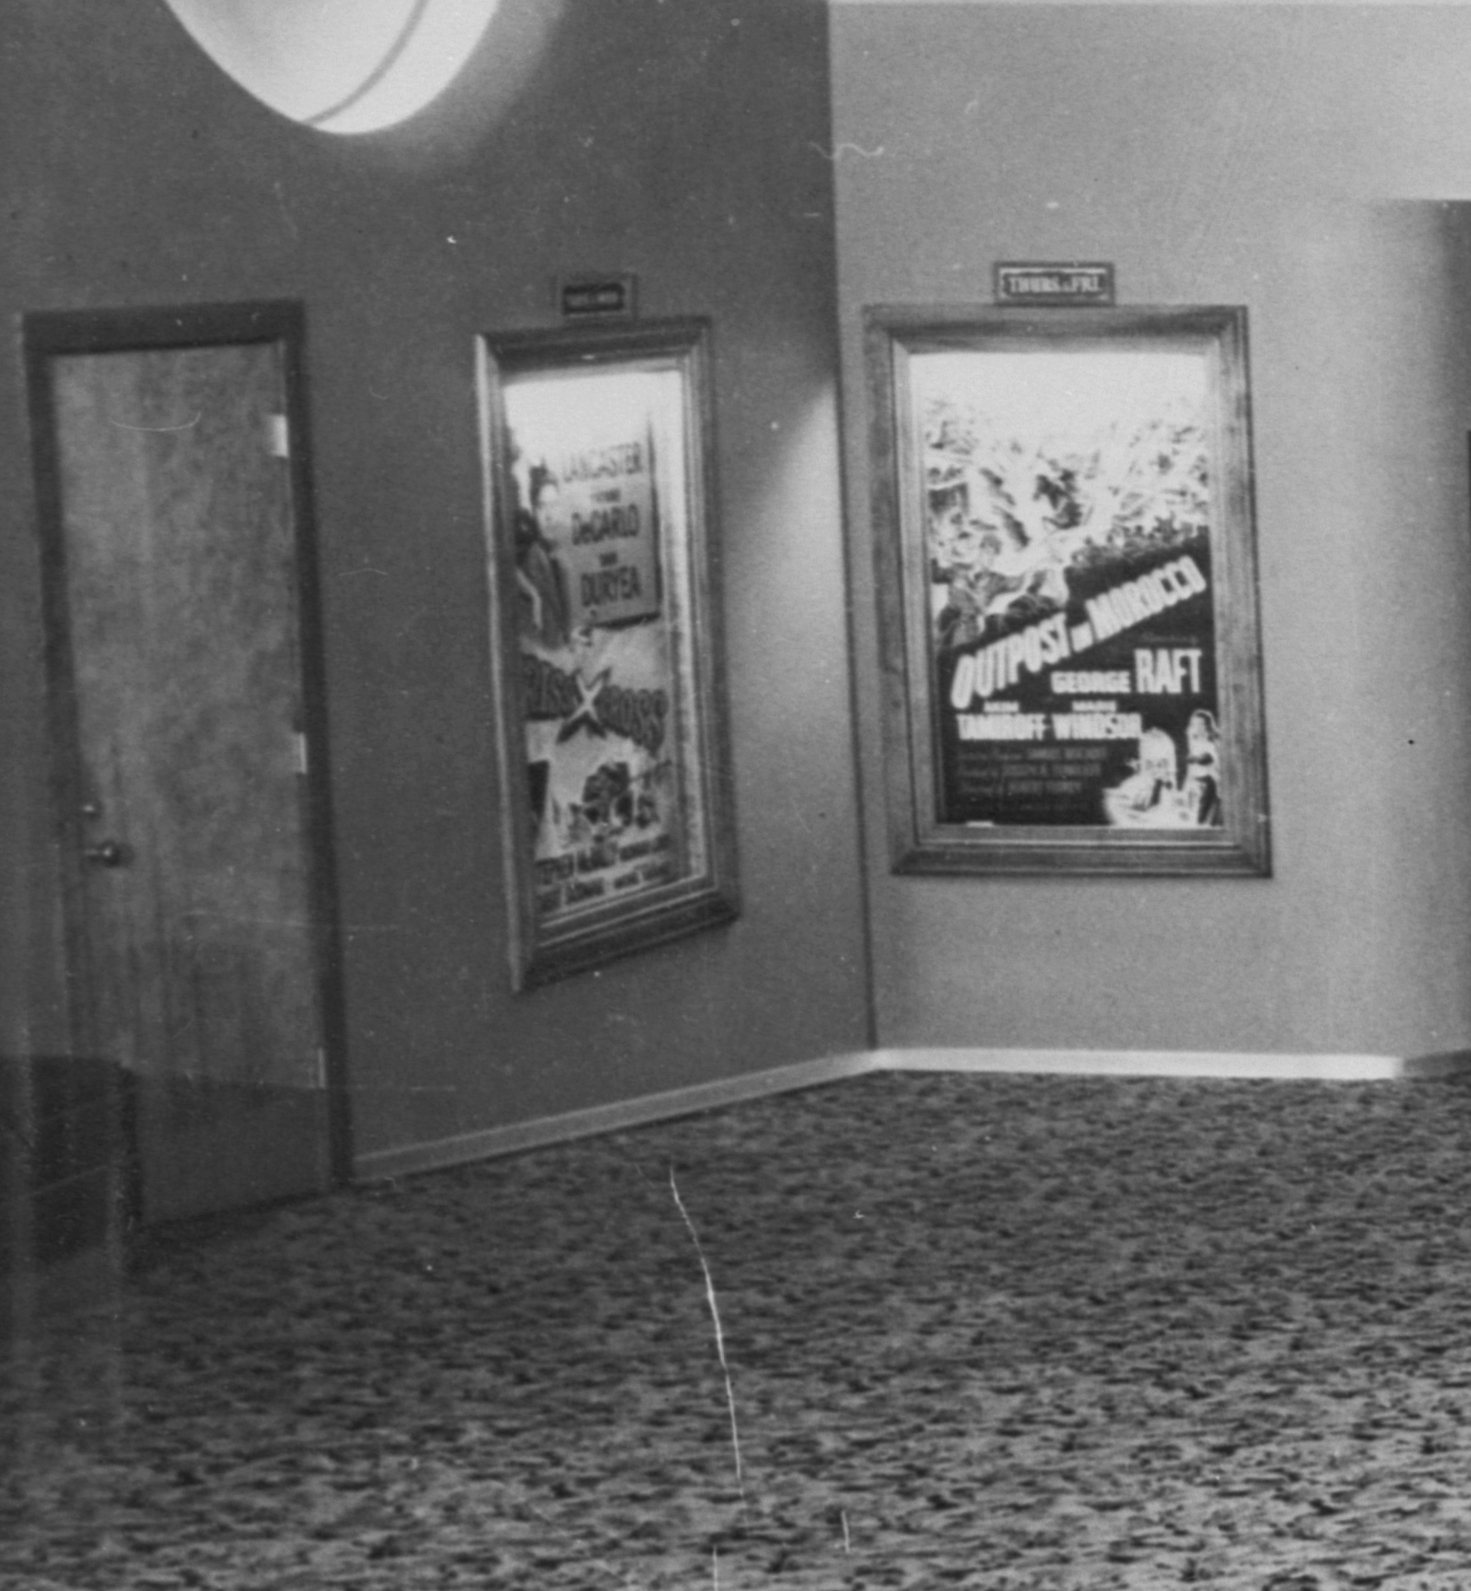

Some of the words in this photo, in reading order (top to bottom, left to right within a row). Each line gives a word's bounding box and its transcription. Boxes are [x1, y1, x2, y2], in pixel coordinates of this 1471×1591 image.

[563, 441, 643, 484] LANCASTER
[580, 565, 640, 607] DURYEA
[951, 611, 1071, 709] OUTPOST
[1085, 554, 1206, 643] MOROCCO
[1051, 670, 1131, 694] GEORGE
[1135, 647, 1202, 694] RAFT
